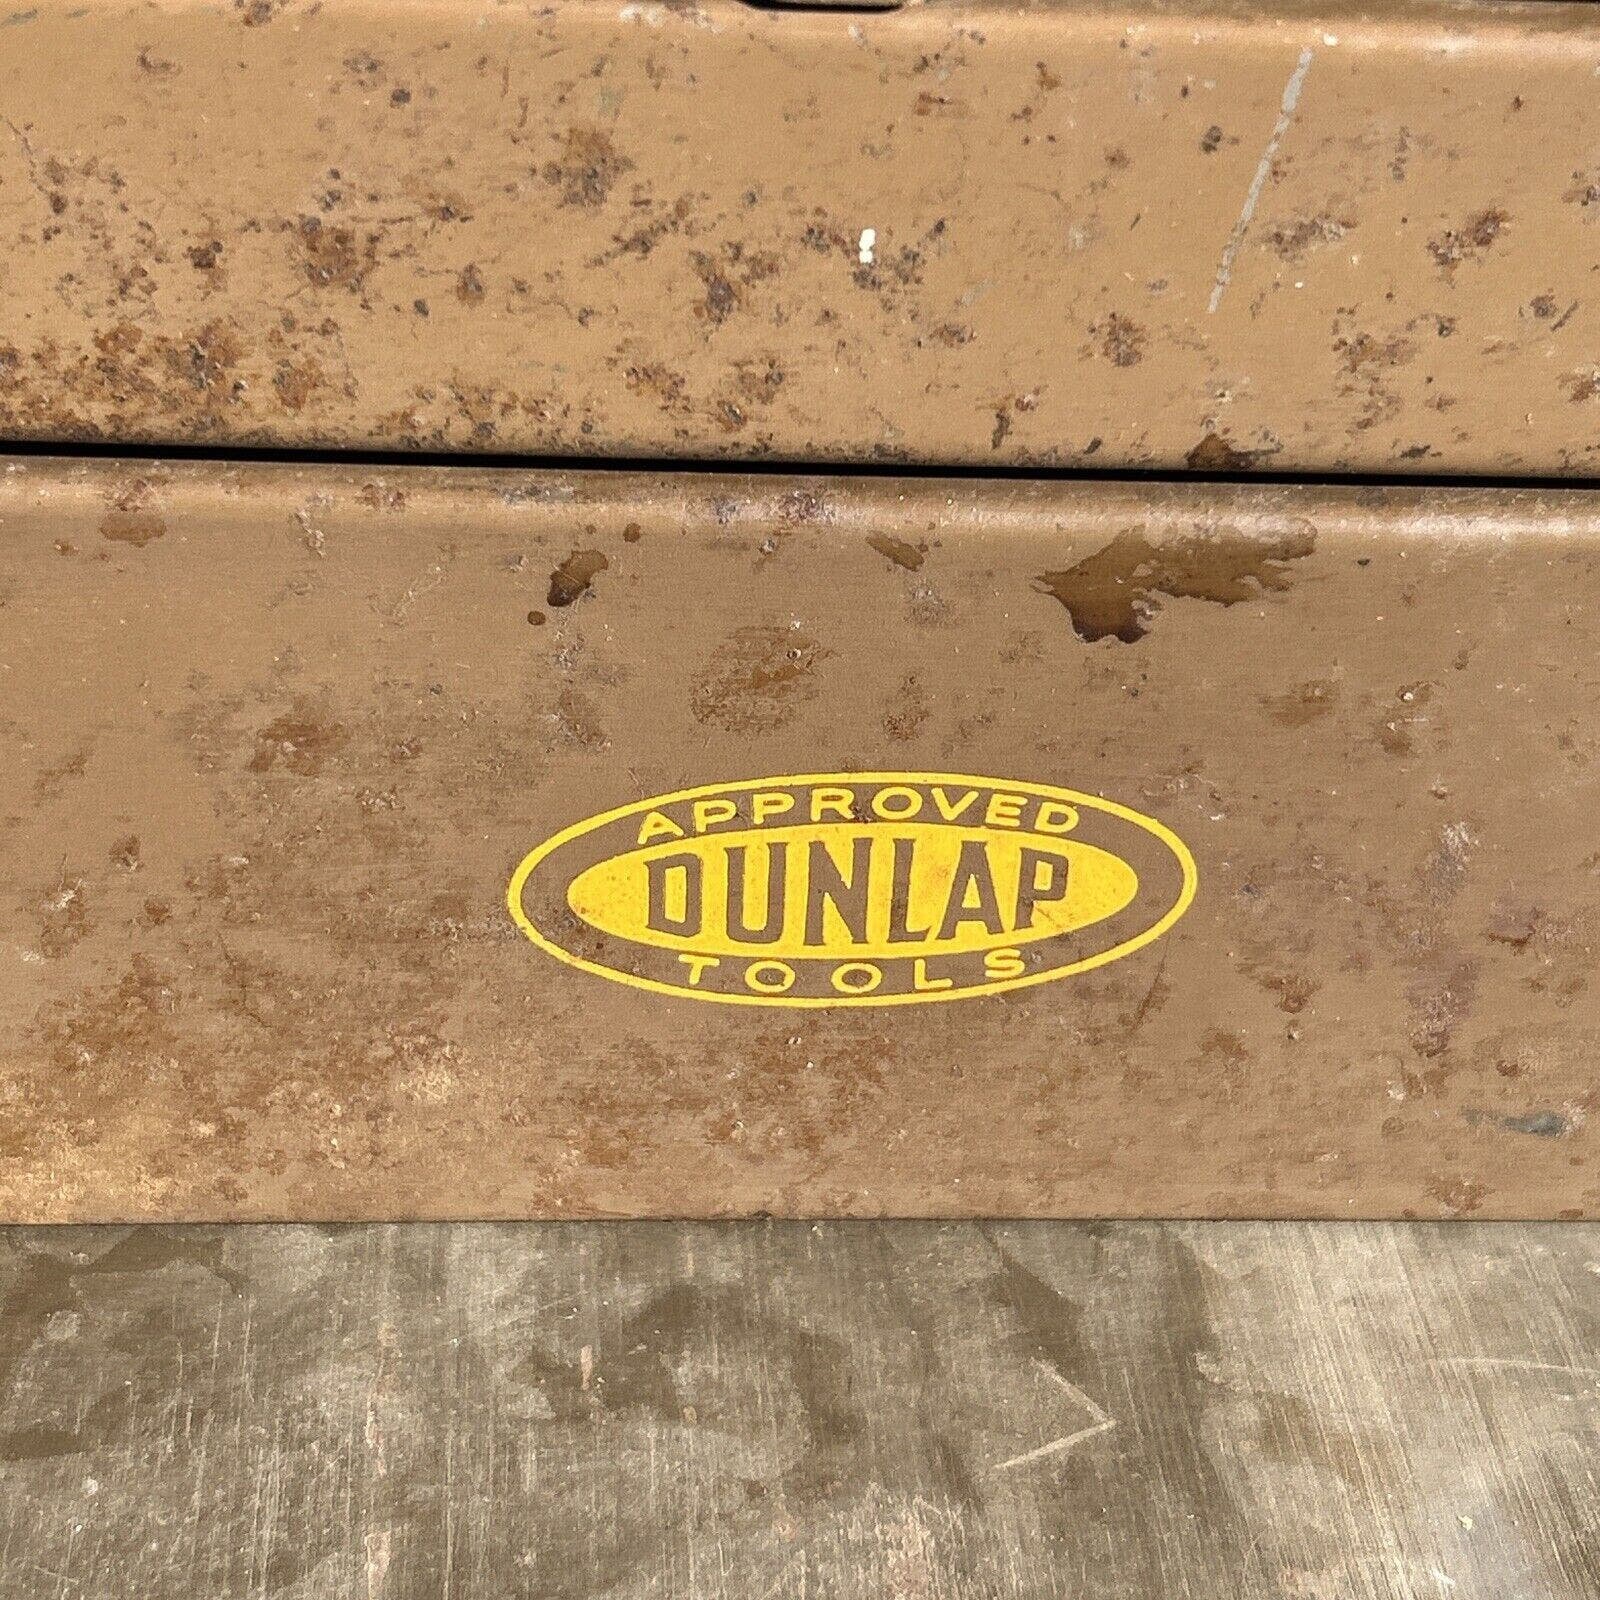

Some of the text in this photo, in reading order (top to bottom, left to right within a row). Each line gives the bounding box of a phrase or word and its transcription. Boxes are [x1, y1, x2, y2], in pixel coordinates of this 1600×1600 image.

[637, 786, 1081, 844] APPROVED
[646, 838, 1070, 946] DUNLAP
[678, 946, 1027, 993] TOOLS
